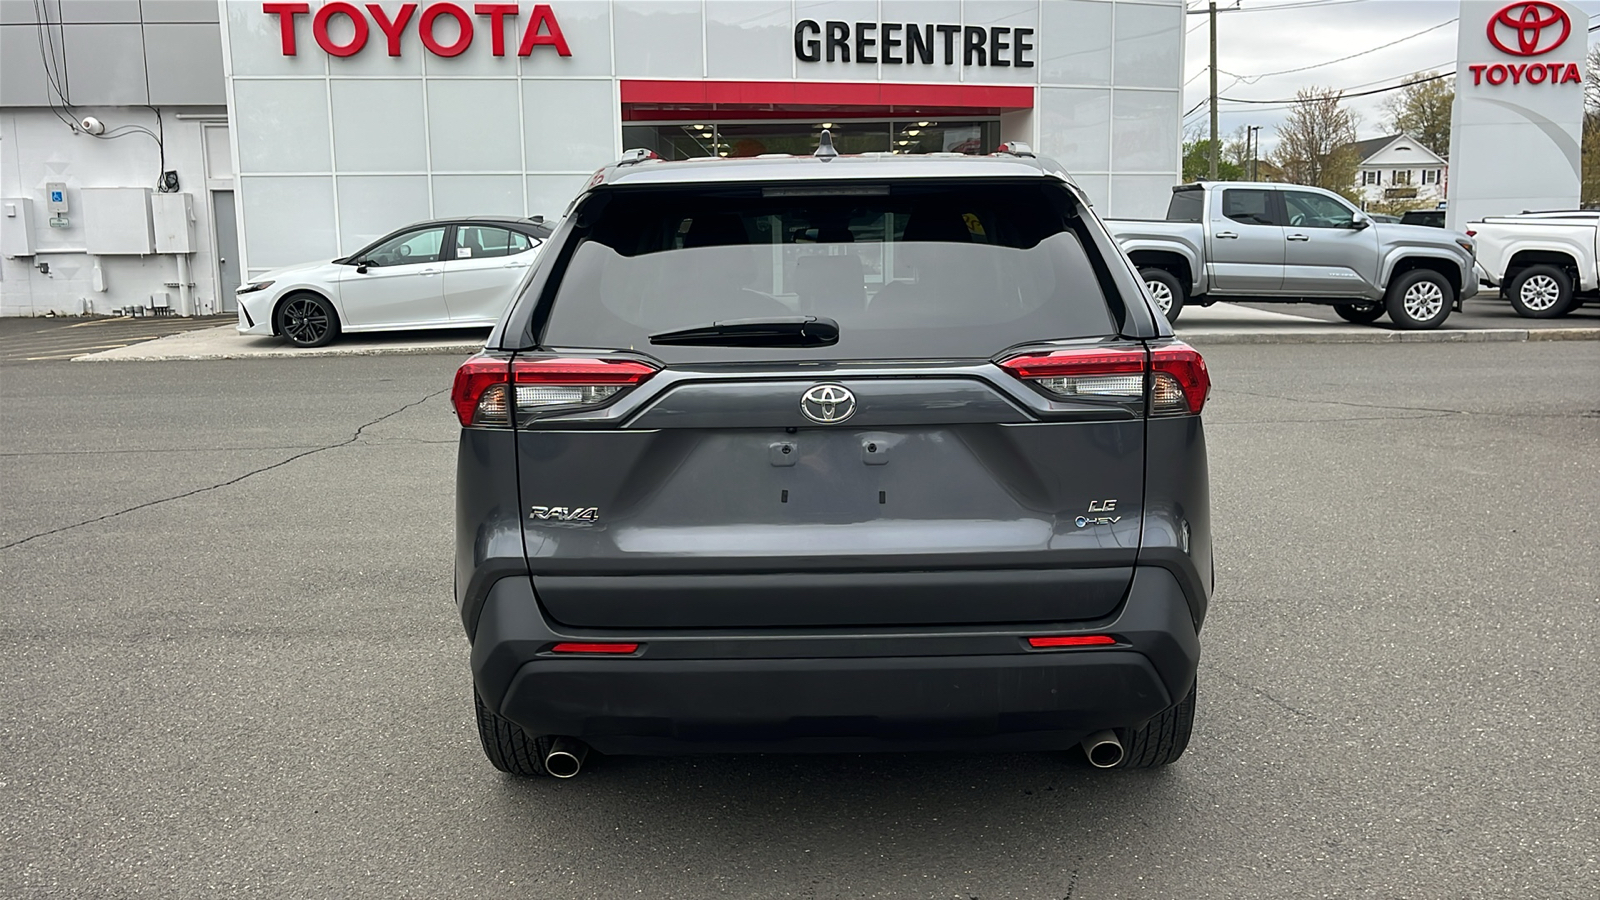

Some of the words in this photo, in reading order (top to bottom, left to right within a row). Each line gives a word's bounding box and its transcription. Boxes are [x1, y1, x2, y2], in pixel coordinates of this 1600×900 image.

[262, 2, 573, 58] TOYOTA
[794, 19, 1035, 68] GREENTREE
[1468, 62, 1582, 86] TOYOTA
[529, 505, 599, 523] RAV4
[1087, 499, 1117, 513] LE
